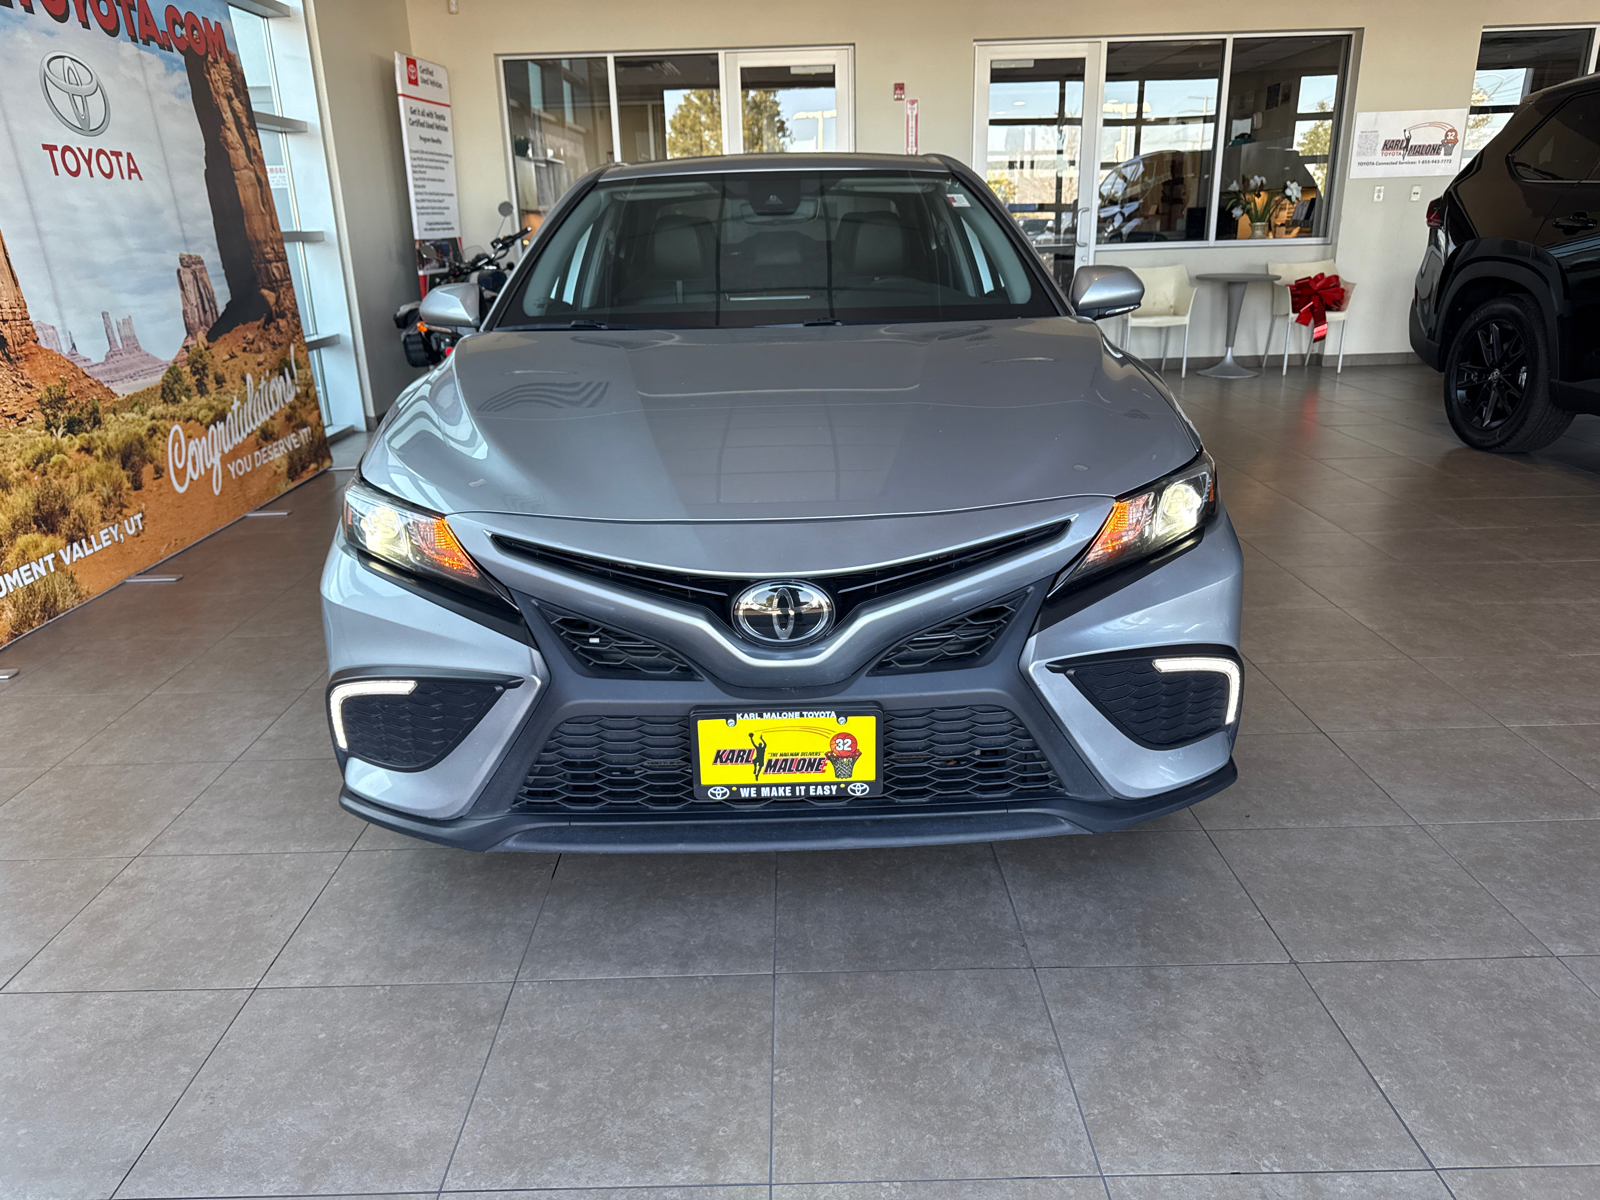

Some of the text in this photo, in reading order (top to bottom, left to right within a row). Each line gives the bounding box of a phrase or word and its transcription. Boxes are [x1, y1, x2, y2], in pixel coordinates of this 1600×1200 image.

[19, 0, 231, 63] YOTA.COM
[1381, 139, 1442, 156] KARL MALONE
[41, 143, 144, 182] TOYOTA
[168, 343, 301, 496] Congratulations!
[227, 426, 313, 479] YOU DESERVE IT!
[58, 523, 125, 566] VALLEY,
[123, 512, 144, 536] UT
[736, 712, 761, 720] KARL
[835, 738, 852, 751] 32
[712, 749, 755, 765] KARL
[763, 757, 827, 775] MALONE
[740, 785, 837, 797] WE MAKE IT EASY
